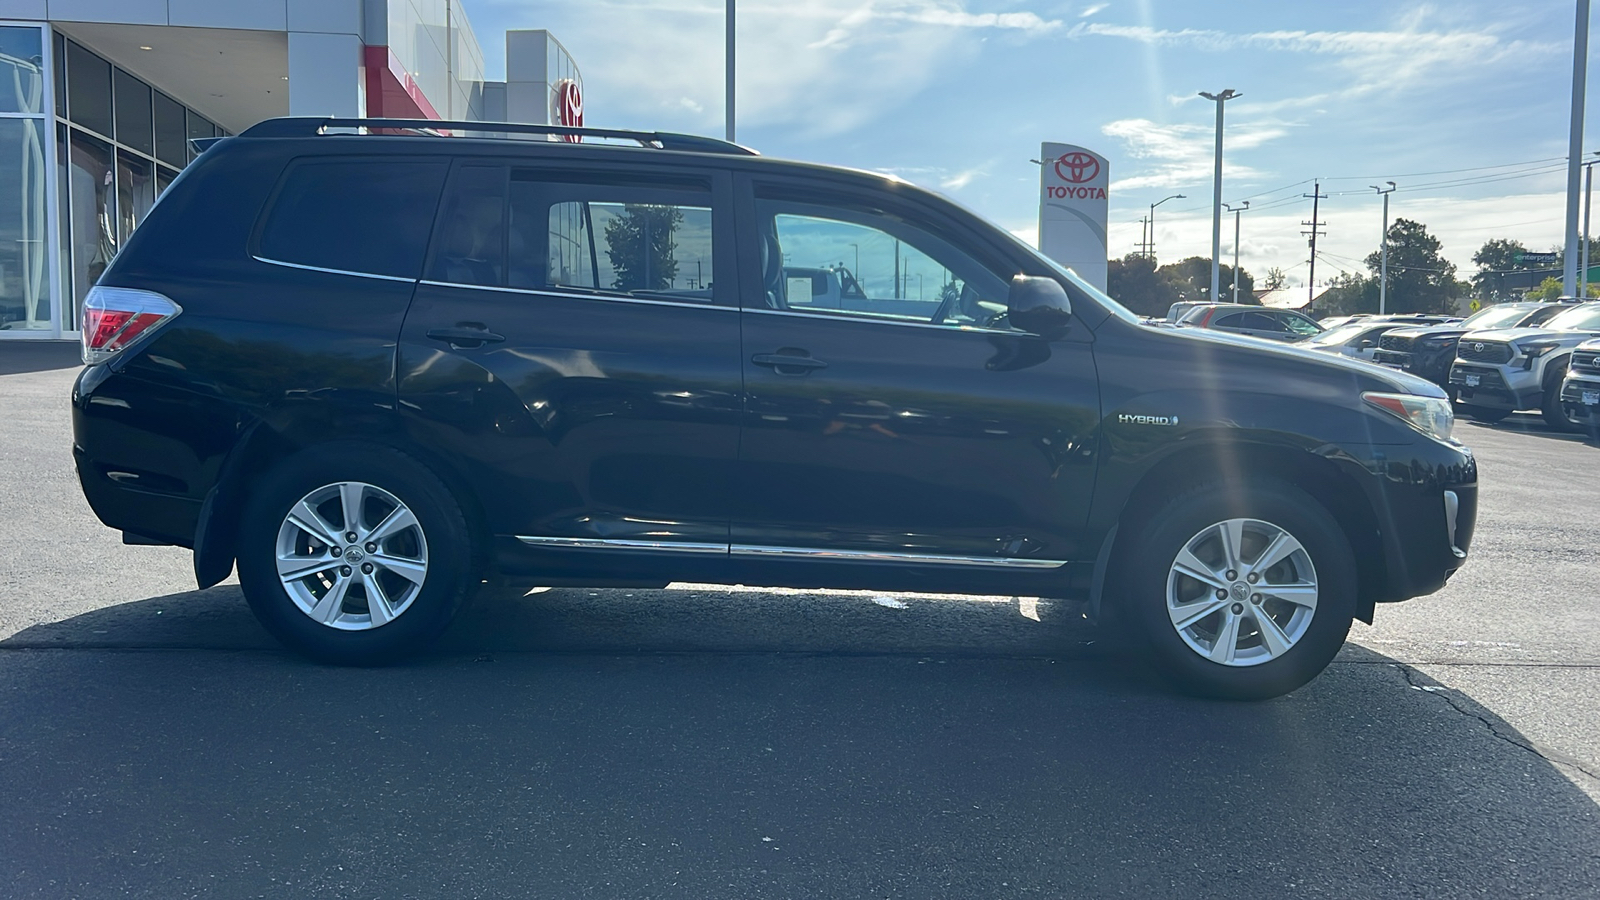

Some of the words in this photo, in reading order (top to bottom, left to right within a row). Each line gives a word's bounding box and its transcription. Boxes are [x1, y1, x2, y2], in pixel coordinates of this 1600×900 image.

[1047, 186, 1107, 200] TOYOTA
[1514, 254, 1556, 262] enterprise
[1118, 414, 1169, 425] HYBRID
